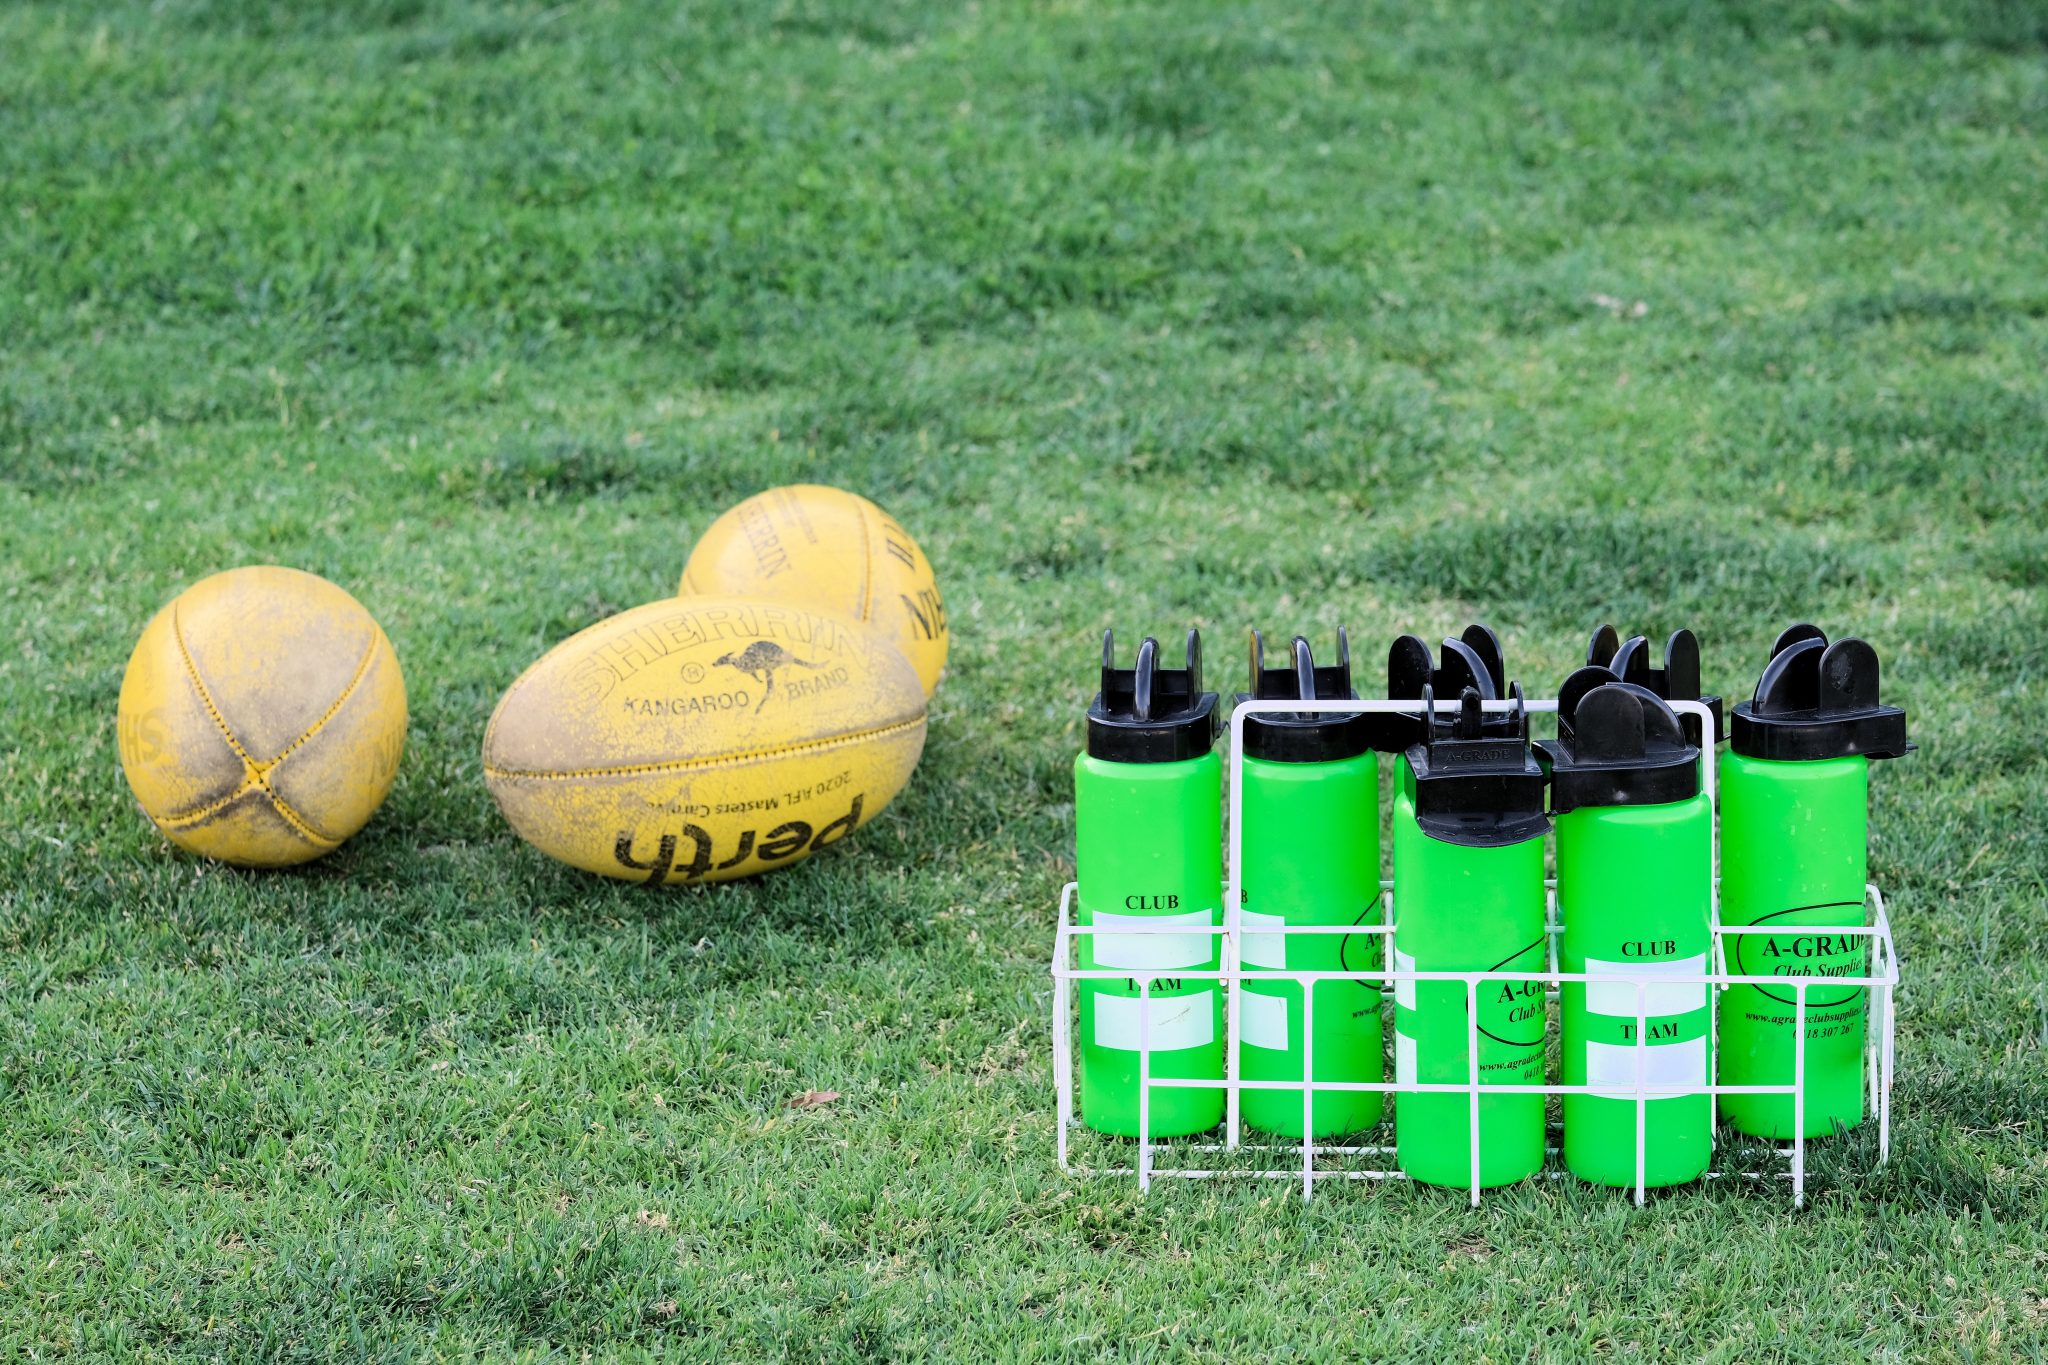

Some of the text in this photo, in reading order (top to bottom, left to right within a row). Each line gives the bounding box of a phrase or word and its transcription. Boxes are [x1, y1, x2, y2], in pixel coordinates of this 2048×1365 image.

[621, 665, 849, 718] KANGAROO BRAND
[1446, 748, 1512, 762] A-GRADE
[815, 770, 851, 796] 2020
[784, 785, 812, 804] AFL
[716, 797, 779, 815] Masters
[614, 793, 865, 887] perth
[1125, 895, 1179, 911] CLUB
[1621, 940, 1676, 957] CLUB
[1125, 977, 1182, 992] TAM
[1509, 1004, 1536, 1023] Club
[1620, 1022, 1678, 1040] TAM
[1821, 1026, 1838, 1038] 307
